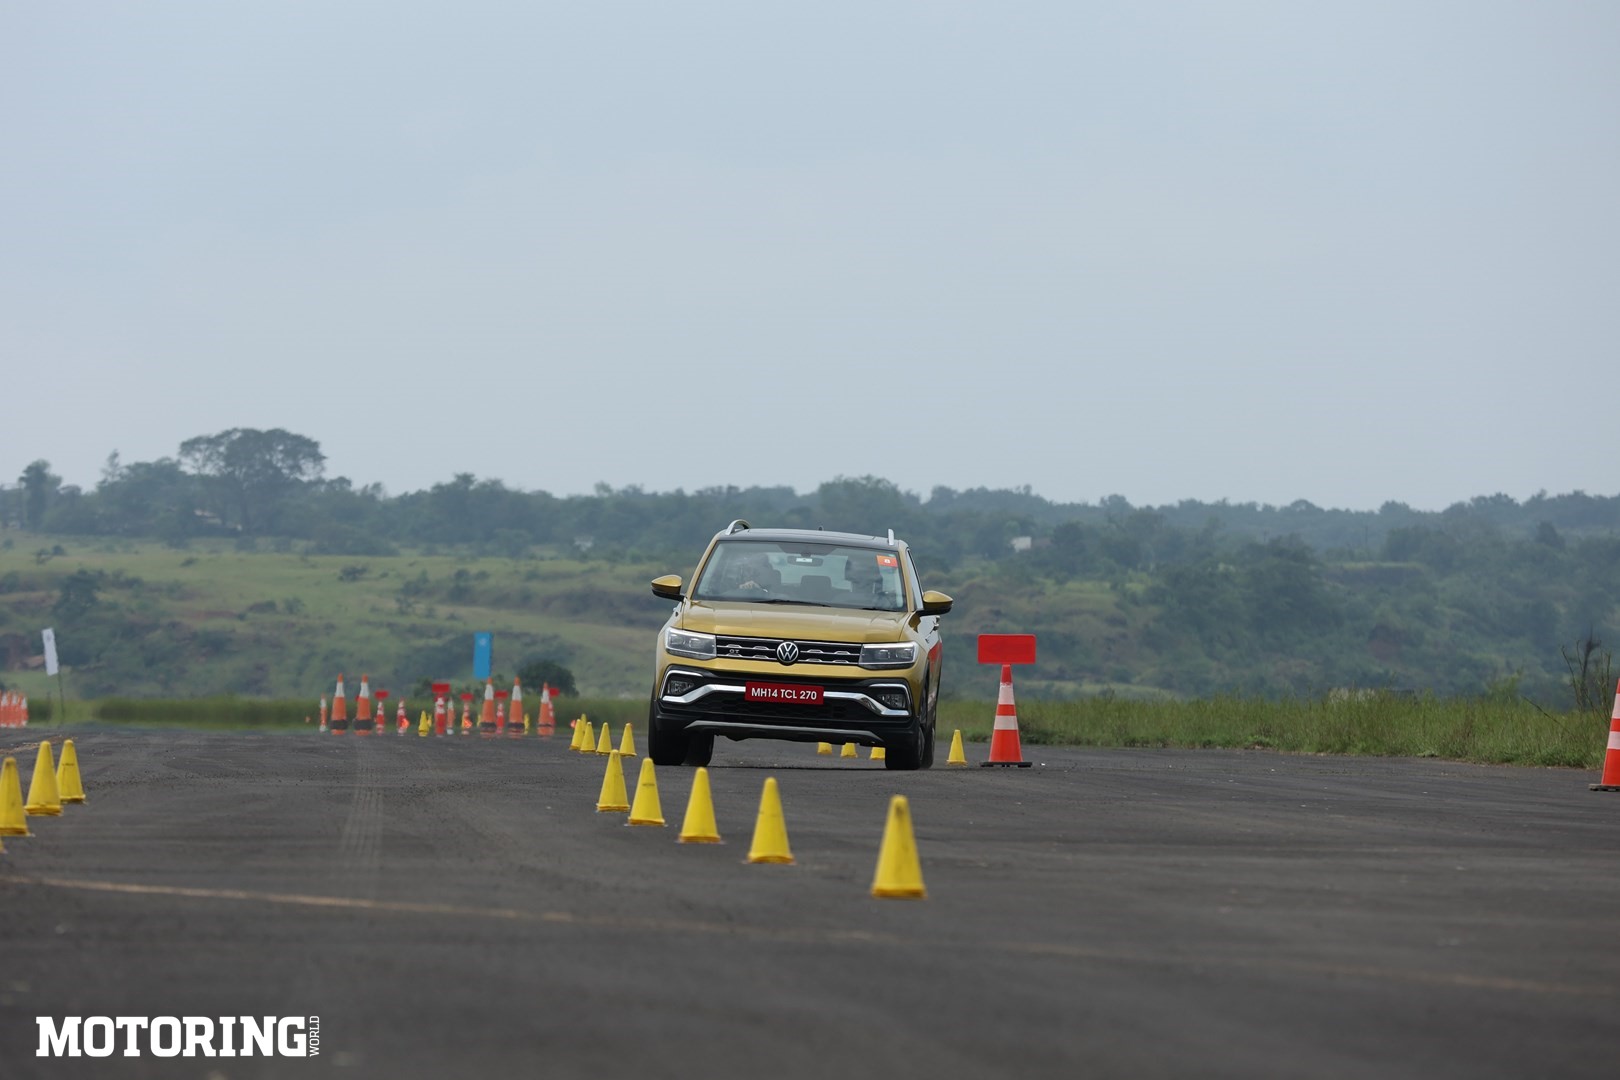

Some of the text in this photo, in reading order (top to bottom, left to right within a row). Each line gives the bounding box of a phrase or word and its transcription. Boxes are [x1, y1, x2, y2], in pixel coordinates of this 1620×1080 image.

[751, 687, 817, 700] MH14 TCL 270
